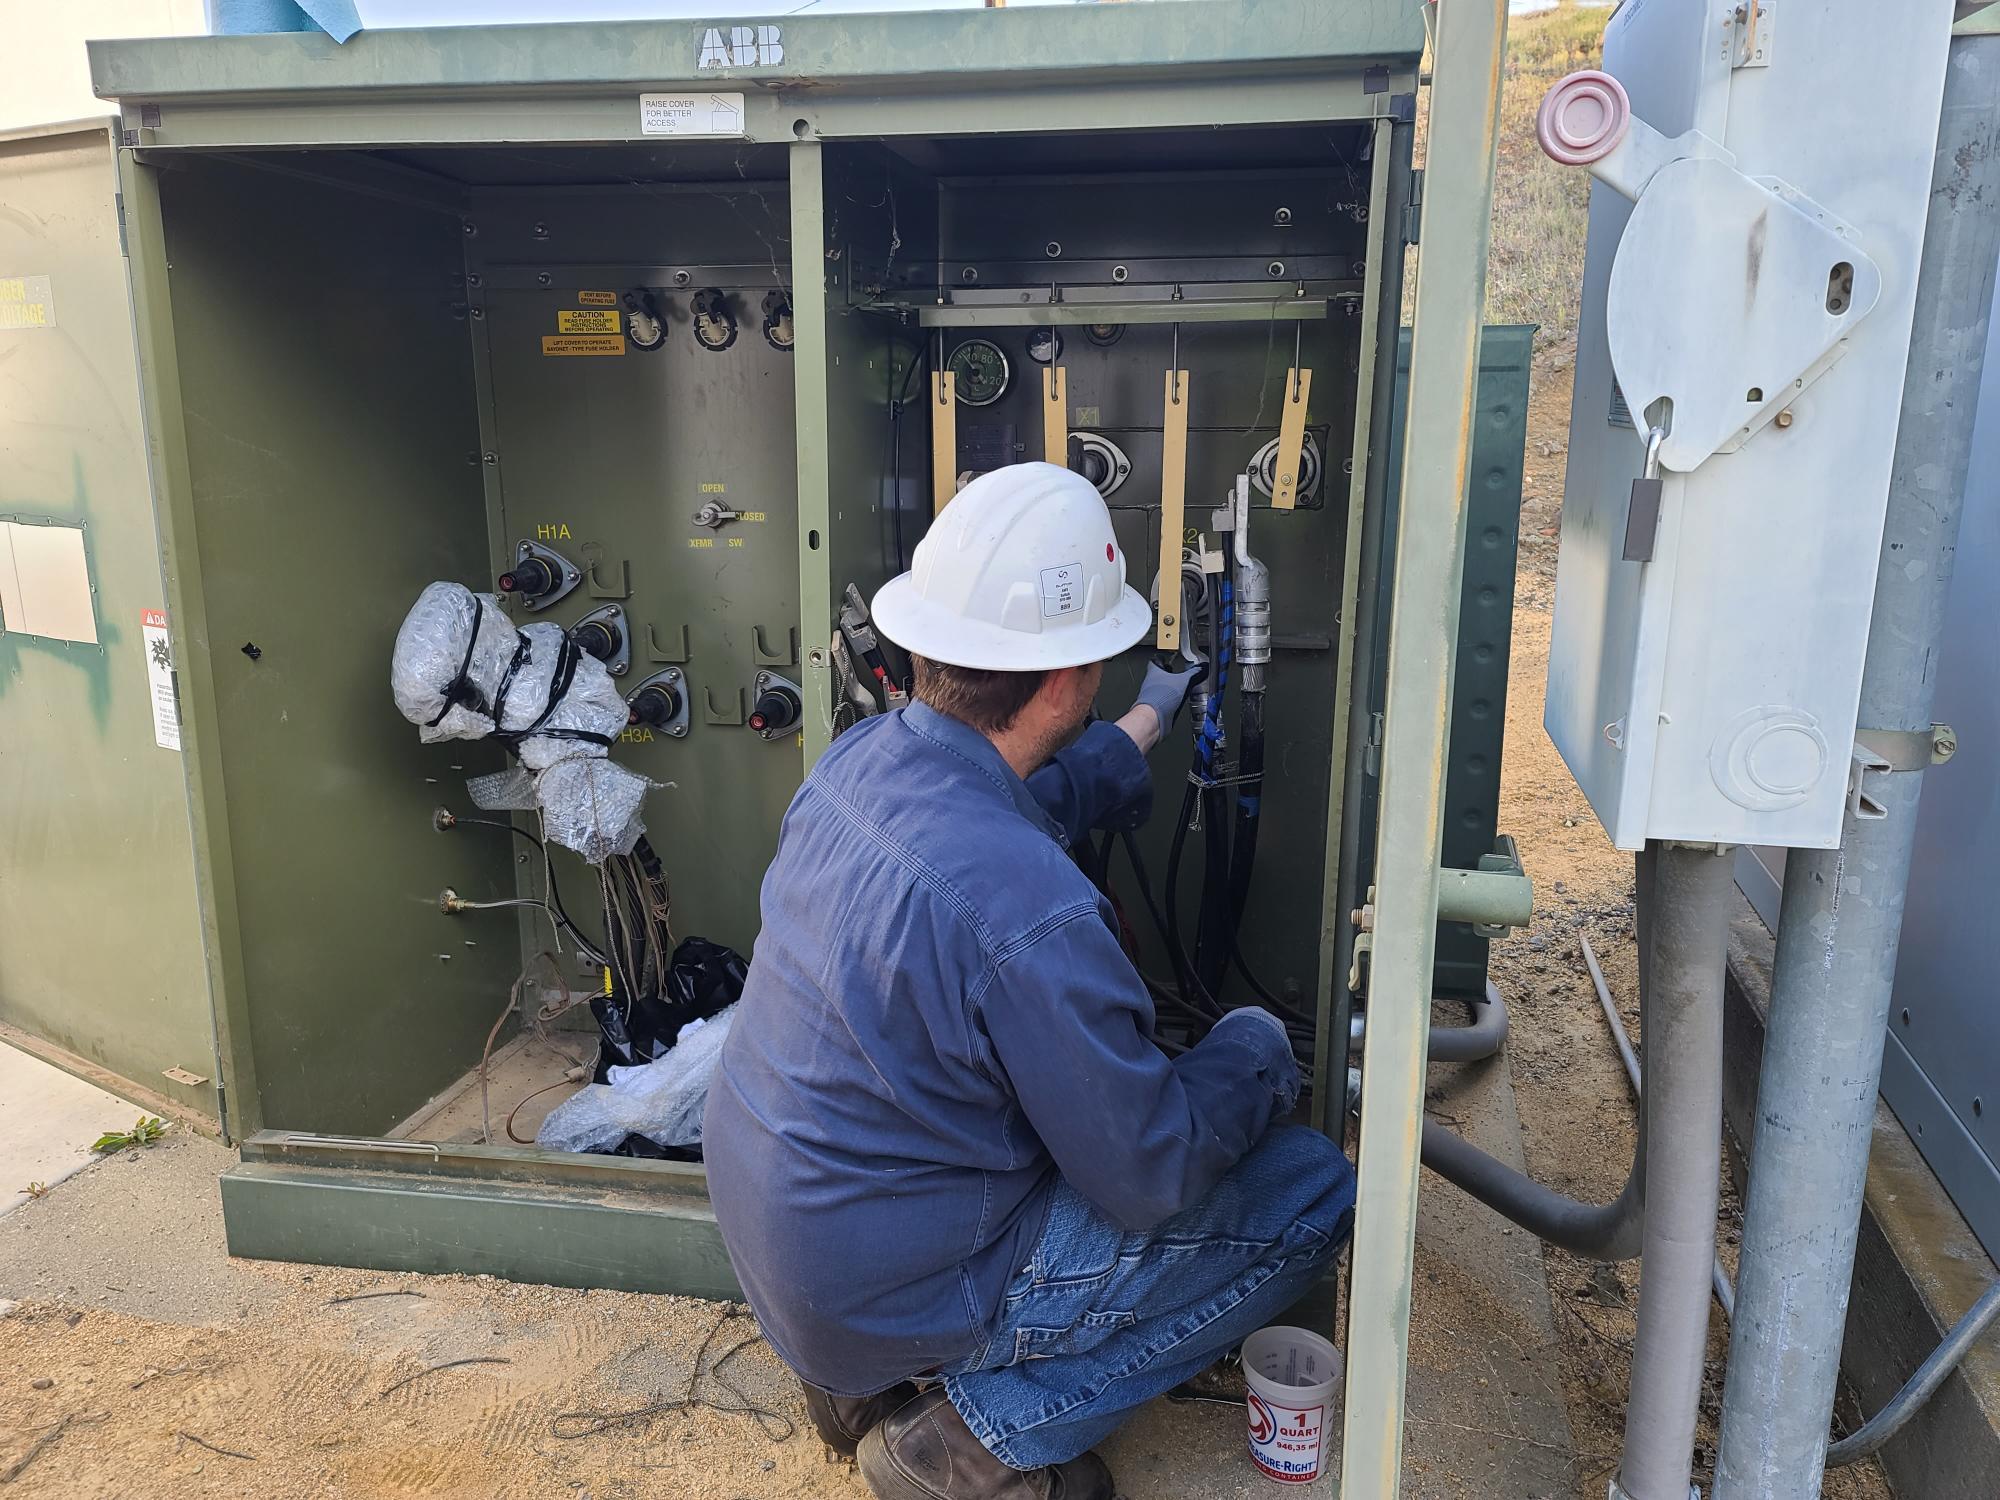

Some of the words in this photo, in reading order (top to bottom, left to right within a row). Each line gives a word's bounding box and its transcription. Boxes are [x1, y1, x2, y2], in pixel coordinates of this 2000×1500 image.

[698, 25, 785, 68] ABB
[646, 100, 667, 108] RAISE
[669, 100, 695, 108] COVER
[981, 355, 993, 364] 80
[1079, 408, 1097, 425] X1
[702, 484, 725, 493] OPEN
[735, 512, 765, 521] CLOSED
[537, 524, 571, 539] H1A
[690, 539, 713, 548] XFMR
[728, 538, 743, 547] SW
[621, 727, 654, 743] H3A
[1294, 1413, 1306, 1428] 1
[1280, 1426, 1319, 1437] QUART
[1276, 1441, 1306, 1452] 946,35
[1308, 1441, 1318, 1450] ml
[1269, 1469, 1315, 1480] CONTAINER
